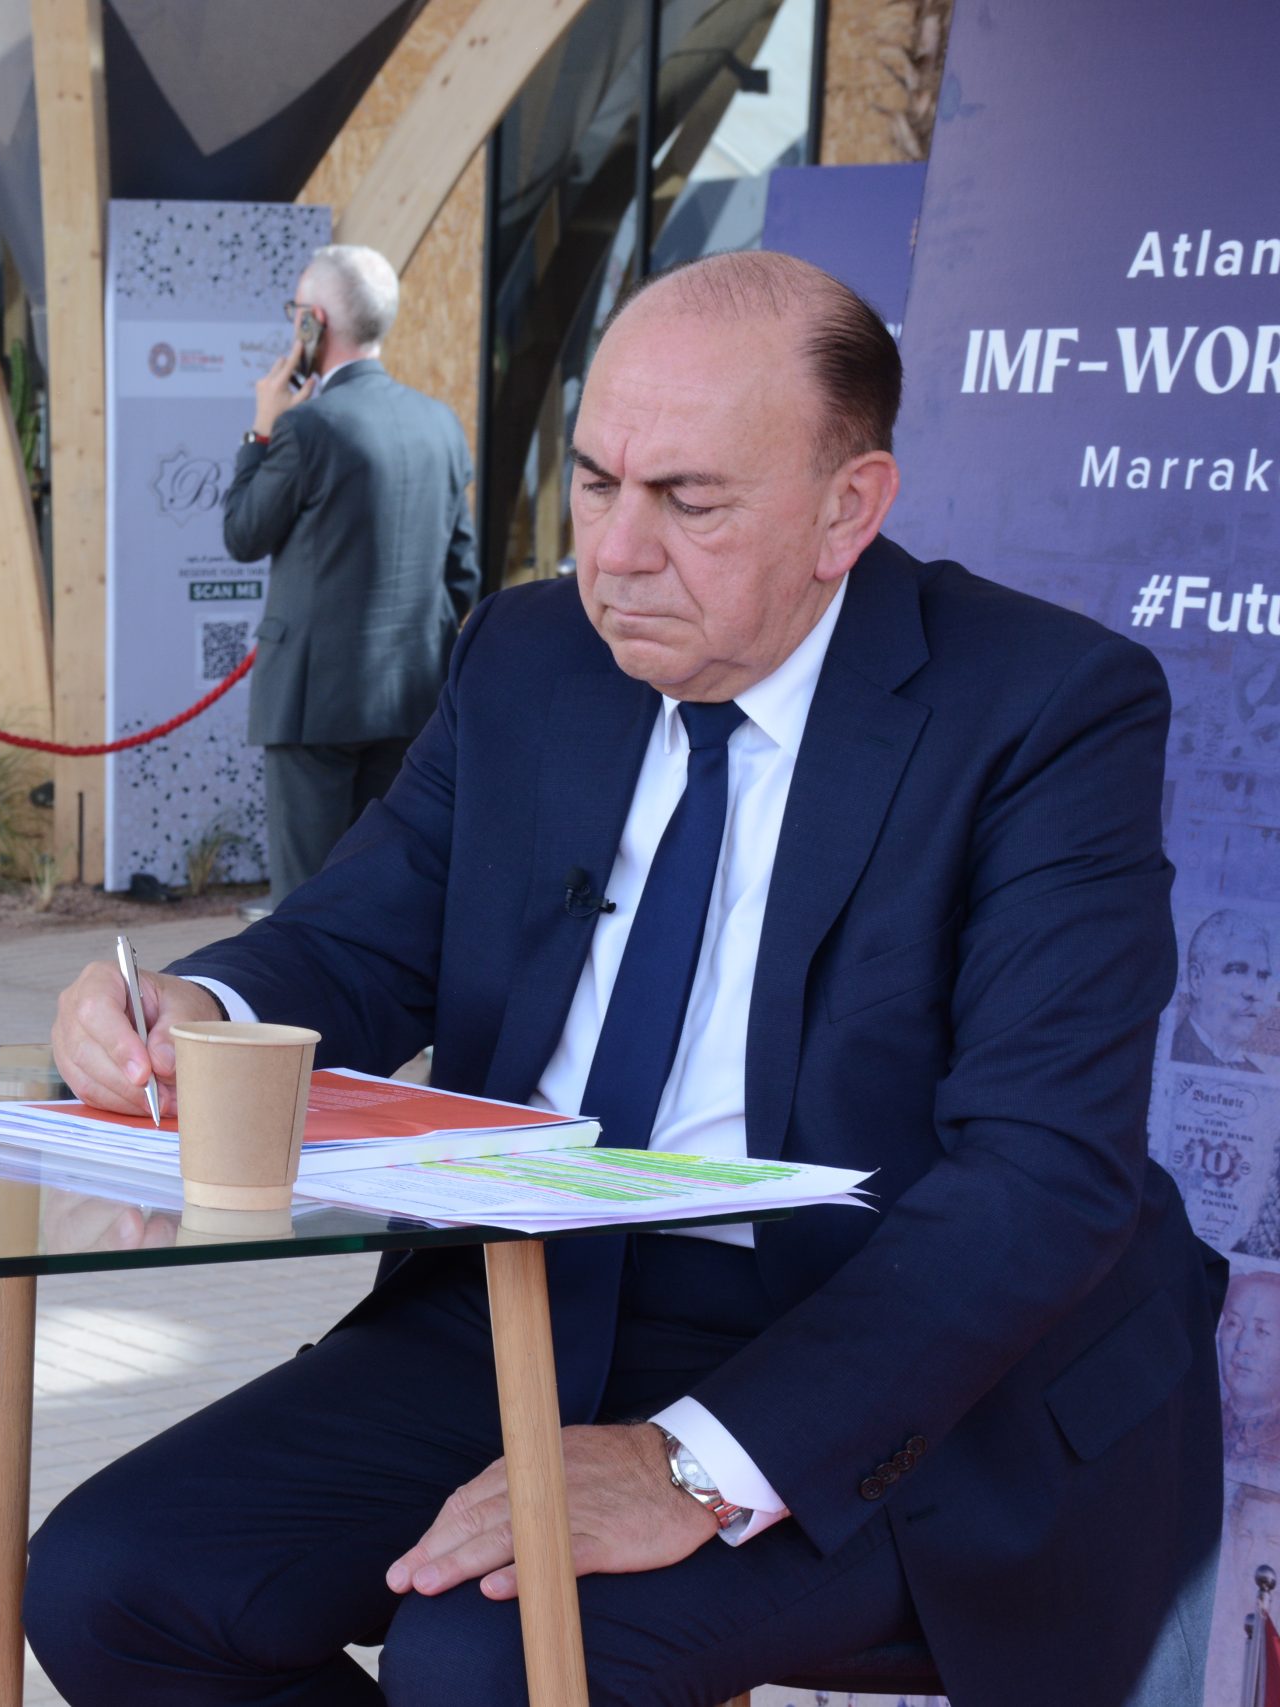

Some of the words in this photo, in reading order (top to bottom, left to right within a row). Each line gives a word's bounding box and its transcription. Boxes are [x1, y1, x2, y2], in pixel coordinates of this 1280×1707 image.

[1126, 228, 1280, 279] Atlan
[960, 325, 1280, 394] IMF-WOR
[1080, 445, 1280, 492] Marrak
[193, 583, 233, 599] SCAN
[236, 583, 258, 598] ME
